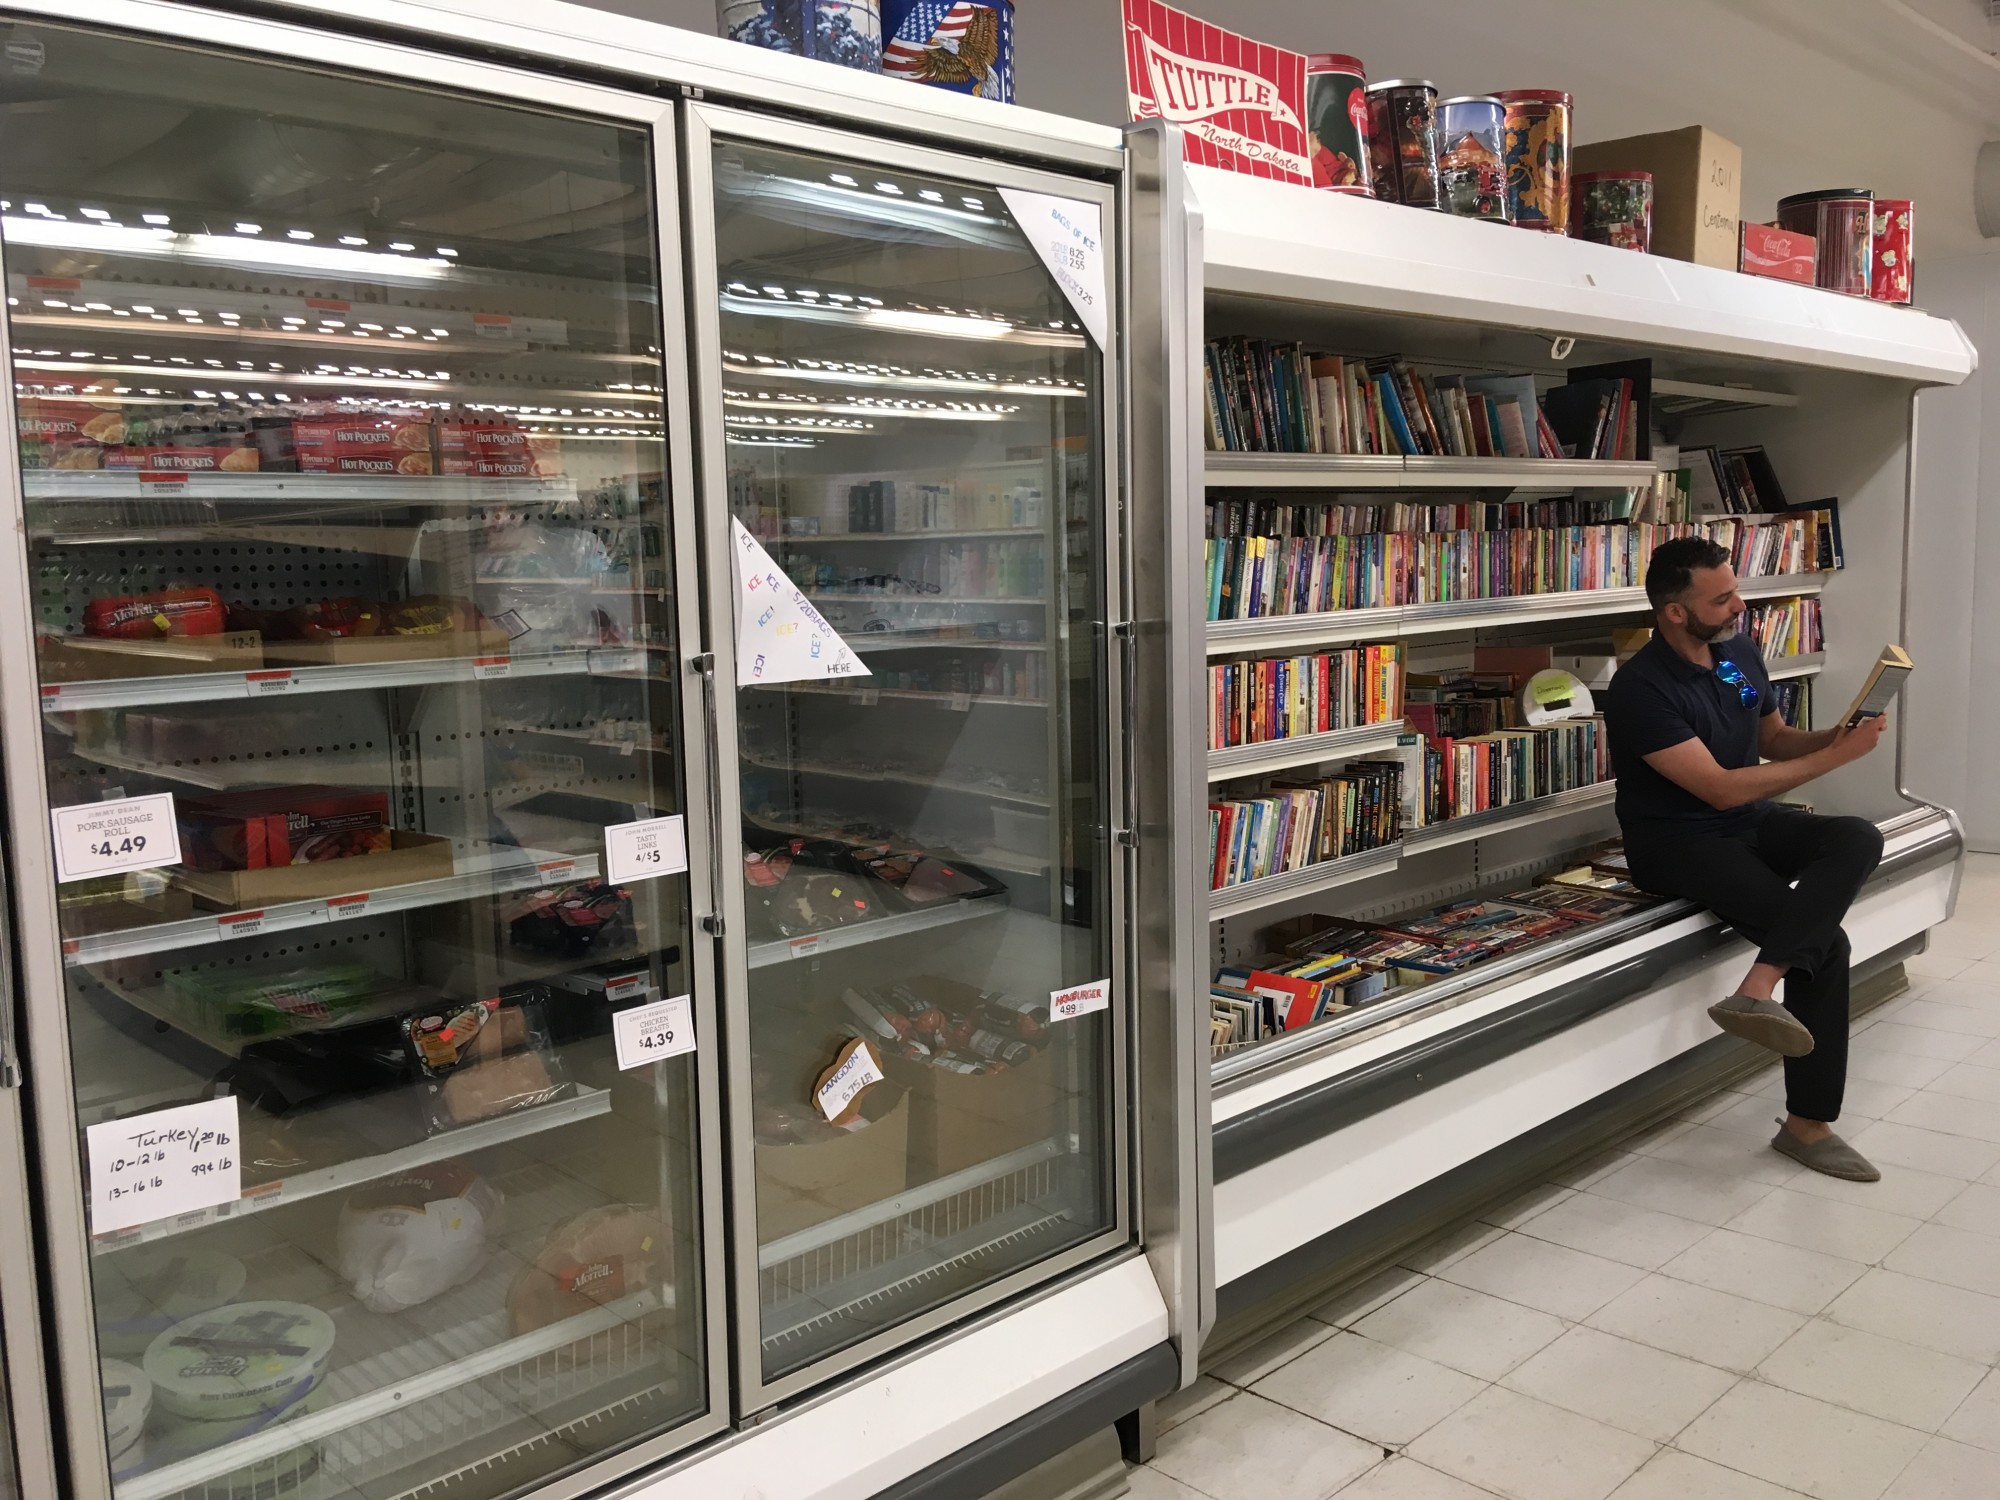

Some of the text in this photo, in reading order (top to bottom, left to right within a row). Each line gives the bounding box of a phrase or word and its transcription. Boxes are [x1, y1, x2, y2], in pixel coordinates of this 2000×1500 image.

[1153, 57, 1271, 111] TUTTLE
[1200, 123, 1300, 172] North Dakota
[1051, 208, 1096, 252] BAGS OF ICE
[35, 419, 77, 432] POCKETS
[337, 431, 391, 442] HOT POCKETS
[476, 433, 525, 444] HOT POCKETS
[154, 456, 214, 467] HOT POCKETS
[341, 459, 394, 470] HOT POCKETS
[478, 462, 527, 473] HOT POCKETS
[741, 533, 755, 552] ICE
[747, 574, 762, 591] ICE
[765, 573, 781, 592] ICE
[231, 637, 256, 649] 12-2
[827, 663, 851, 674] HERE
[88, 805, 141, 819] JIMMY DEAN
[77, 813, 153, 832] PORK SAUSAGE
[104, 827, 130, 837] ROLL
[636, 834, 657, 842] TASTY
[91, 835, 147, 857] $4.49
[637, 841, 657, 850] LINKS
[635, 850, 661, 863] 4/$5
[640, 1015, 669, 1028] CHICKEN
[640, 1023, 670, 1036] BREASTS
[639, 1031, 674, 1049] $4.39
[820, 1052, 859, 1096] LANGDON
[860, 1072, 873, 1086] LB
[127, 1127, 200, 1150] Turkey
[216, 1133, 230, 1146] lb
[110, 1150, 165, 1173] 10-12 lb
[191, 1157, 232, 1177] 99¢ lb
[109, 1176, 163, 1200] 13-16 lb
[571, 1264, 610, 1291] Morrell
